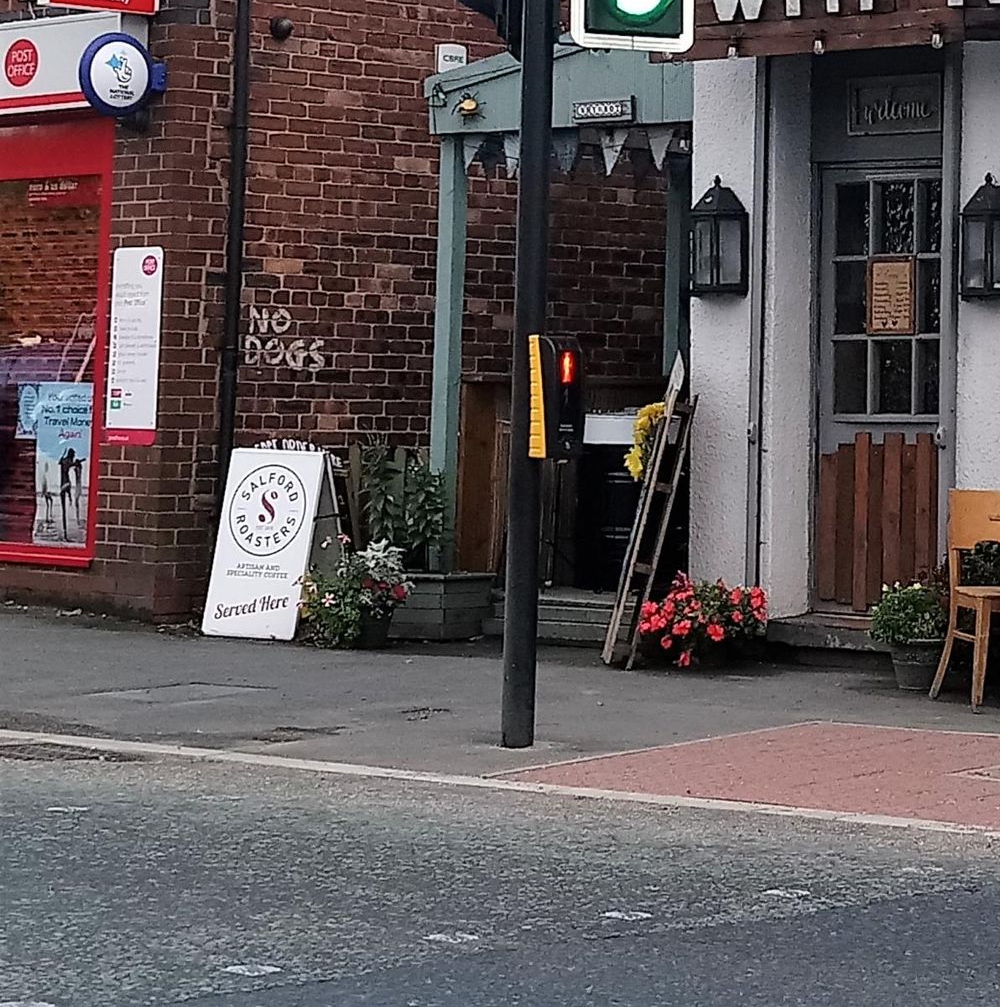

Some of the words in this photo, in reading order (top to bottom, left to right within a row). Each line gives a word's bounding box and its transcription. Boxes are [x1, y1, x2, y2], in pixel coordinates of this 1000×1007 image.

[11, 49, 34, 63] POST
[7, 63, 36, 78] OFFICE
[249, 305, 292, 334] NO
[244, 335, 326, 372] DOGS
[44, 416, 69, 426] Travel
[70, 417, 92, 427] Mone
[241, 472, 299, 502] SALFORD
[236, 514, 297, 548] ROASTERS
[214, 598, 257, 620] Served
[259, 595, 289, 612] Here
